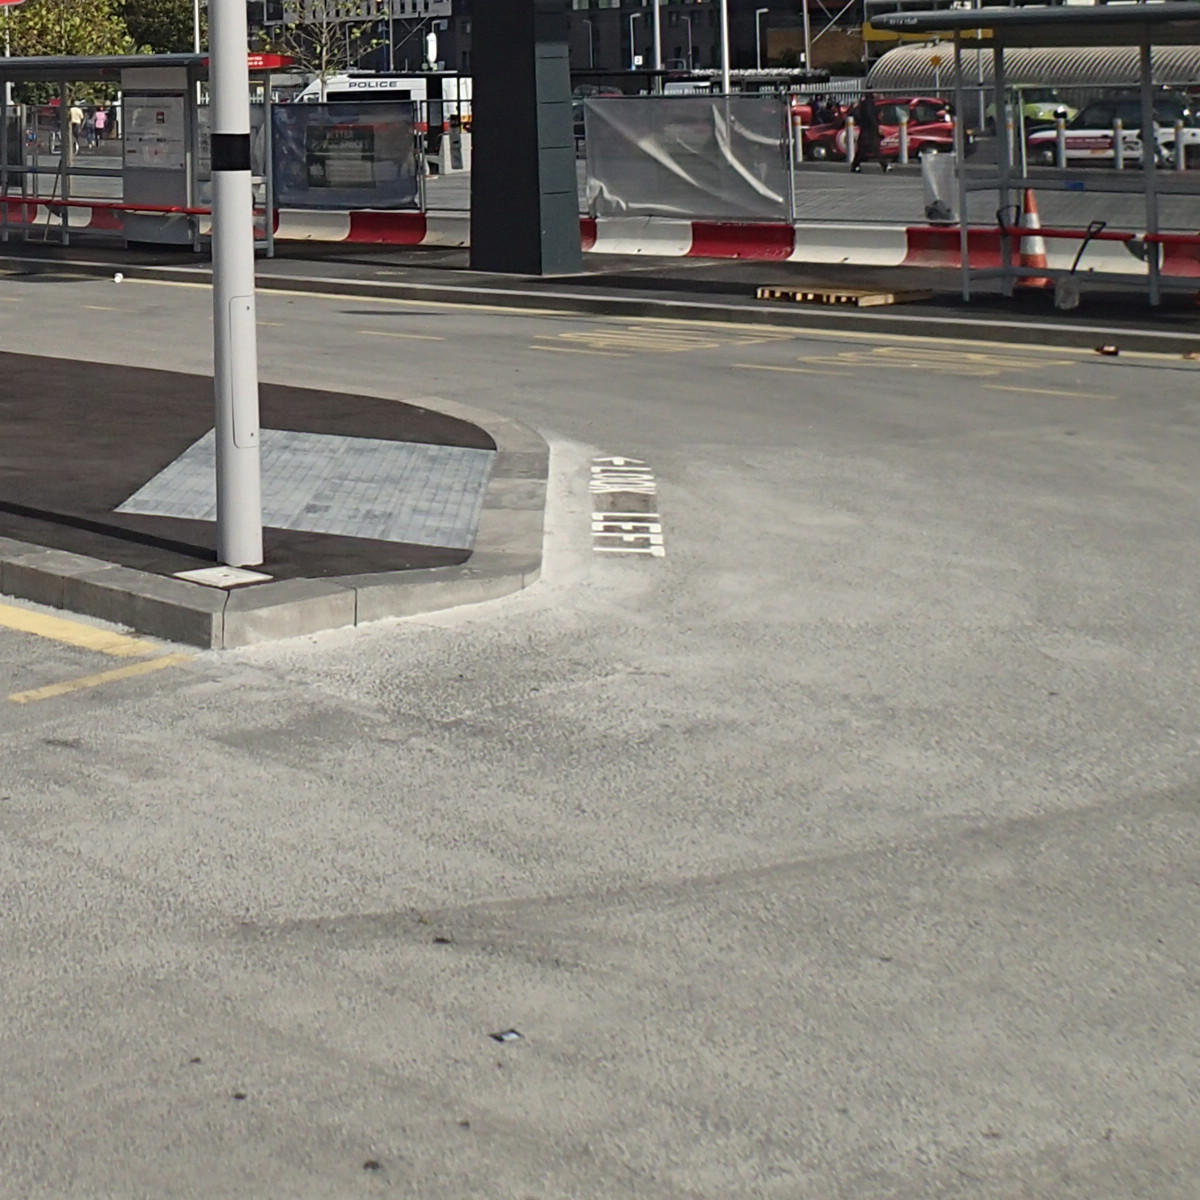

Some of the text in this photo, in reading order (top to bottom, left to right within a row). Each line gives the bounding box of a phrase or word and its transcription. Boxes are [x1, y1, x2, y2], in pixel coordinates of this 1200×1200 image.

[348, 80, 398, 89] POLICE
[588, 465, 666, 558] LOOK LEFT
